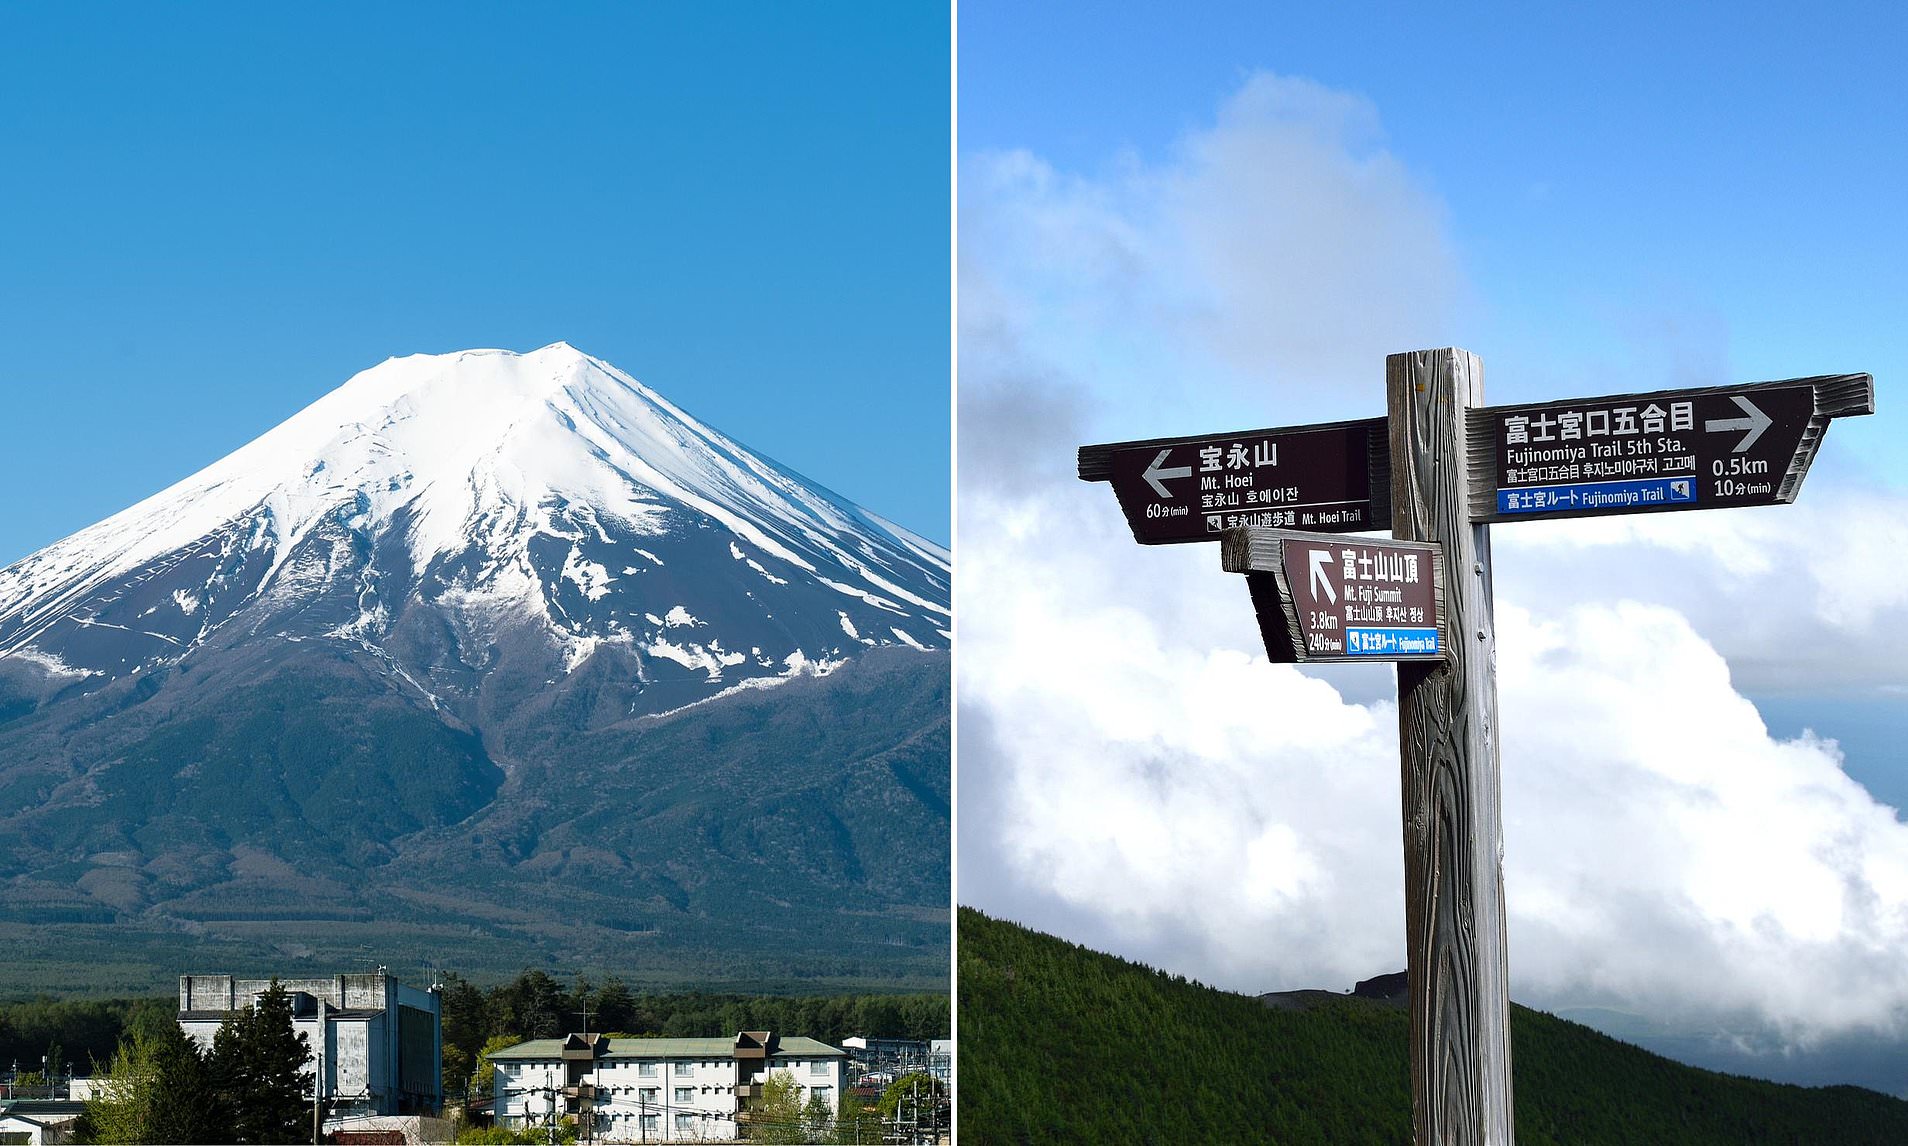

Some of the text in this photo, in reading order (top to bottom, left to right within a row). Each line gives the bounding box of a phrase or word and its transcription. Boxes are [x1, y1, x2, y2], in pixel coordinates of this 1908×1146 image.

[1504, 401, 1694, 445] 富士宮口五合目
[1199, 440, 1278, 472] 宝永山
[1507, 437, 1686, 467] Fujinomiya Trail 5th Sta.
[1583, 455, 1696, 478] 후지노미야구치 고고메
[1712, 457, 1768, 477] 0.5km
[1201, 473, 1253, 491] Mt. Hoei
[1201, 492, 1240, 508] 宝永山
[1246, 487, 1299, 504] 호에이잔
[1507, 489, 1579, 510] 富士宮ルート
[1582, 487, 1664, 508] Fujinomiya Trail
[1302, 509, 1361, 526] Mt. Hoei Trail
[1341, 549, 1419, 584] 富士山山頂
[1344, 585, 1402, 605] Mt. Fuji Summit
[1310, 611, 1338, 630] 3.8km
[1386, 606, 1407, 623] 후지산
